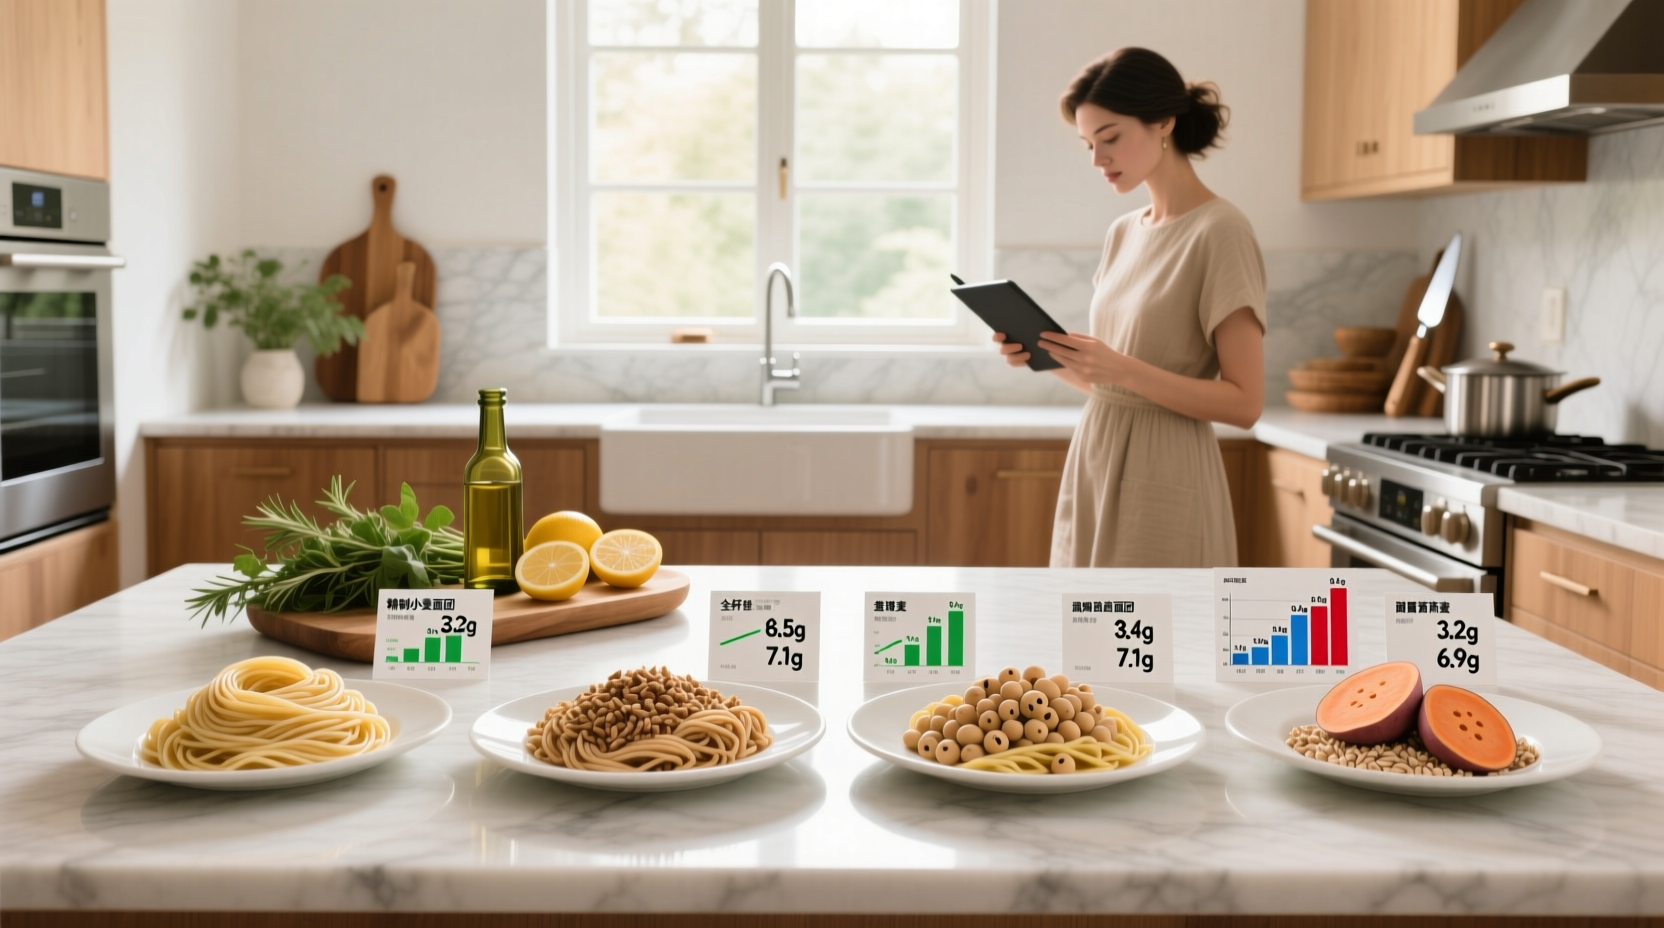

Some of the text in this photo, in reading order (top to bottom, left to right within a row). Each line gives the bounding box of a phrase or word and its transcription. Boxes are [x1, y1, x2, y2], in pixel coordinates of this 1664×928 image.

[1115, 620, 1153, 645] 3.4g
[1437, 620, 1478, 645] 3.2g
[766, 646, 802, 671] 7.1g
[1117, 648, 1153, 672] 7.1g
[1437, 648, 1479, 674] 6.9g
